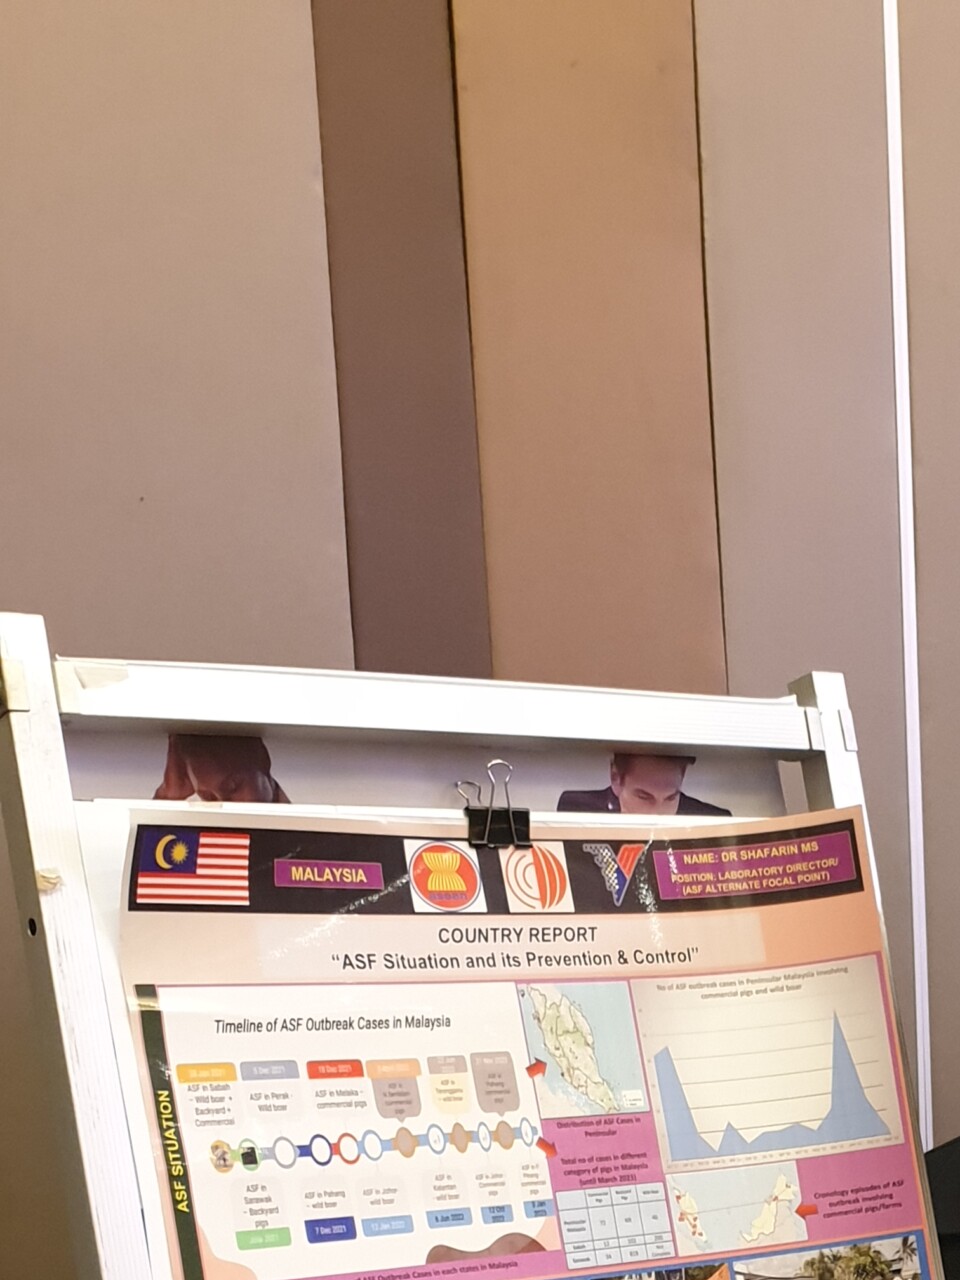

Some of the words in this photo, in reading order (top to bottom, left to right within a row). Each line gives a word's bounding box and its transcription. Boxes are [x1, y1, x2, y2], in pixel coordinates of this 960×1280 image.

[684, 851, 719, 865] NAME:
[721, 850, 737, 862] DR
[740, 844, 798, 860] SHAFARIN
[801, 842, 818, 853] MS
[291, 865, 367, 884] MALAYSIA
[671, 872, 716, 884] POSITION:
[718, 864, 784, 880] LABORATORY
[682, 884, 702, 895] (ASF
[704, 878, 760, 893] ALTERNATE
[762, 875, 795, 889] FOCAL
[797, 872, 830, 885] POINT)
[438, 927, 523, 944] COUNTRY
[529, 927, 598, 942] REPORT
[384, 953, 459, 970] Situation
[466, 952, 496, 969] and
[501, 953, 521, 968] its
[527, 951, 612, 968] Prevention
[617, 950, 628, 965] &
[215, 1019, 263, 1034] Timeline
[266, 1018, 277, 1032] of
[281, 1018, 303, 1031] ASF
[306, 1016, 355, 1031] Outbreak
[358, 1016, 389, 1030] Cases
[393, 1016, 402, 1028] in
[405, 1014, 450, 1031] Malaysia
[158, 1090, 184, 1176] SITUATION
[174, 1181, 189, 1212] ASF
